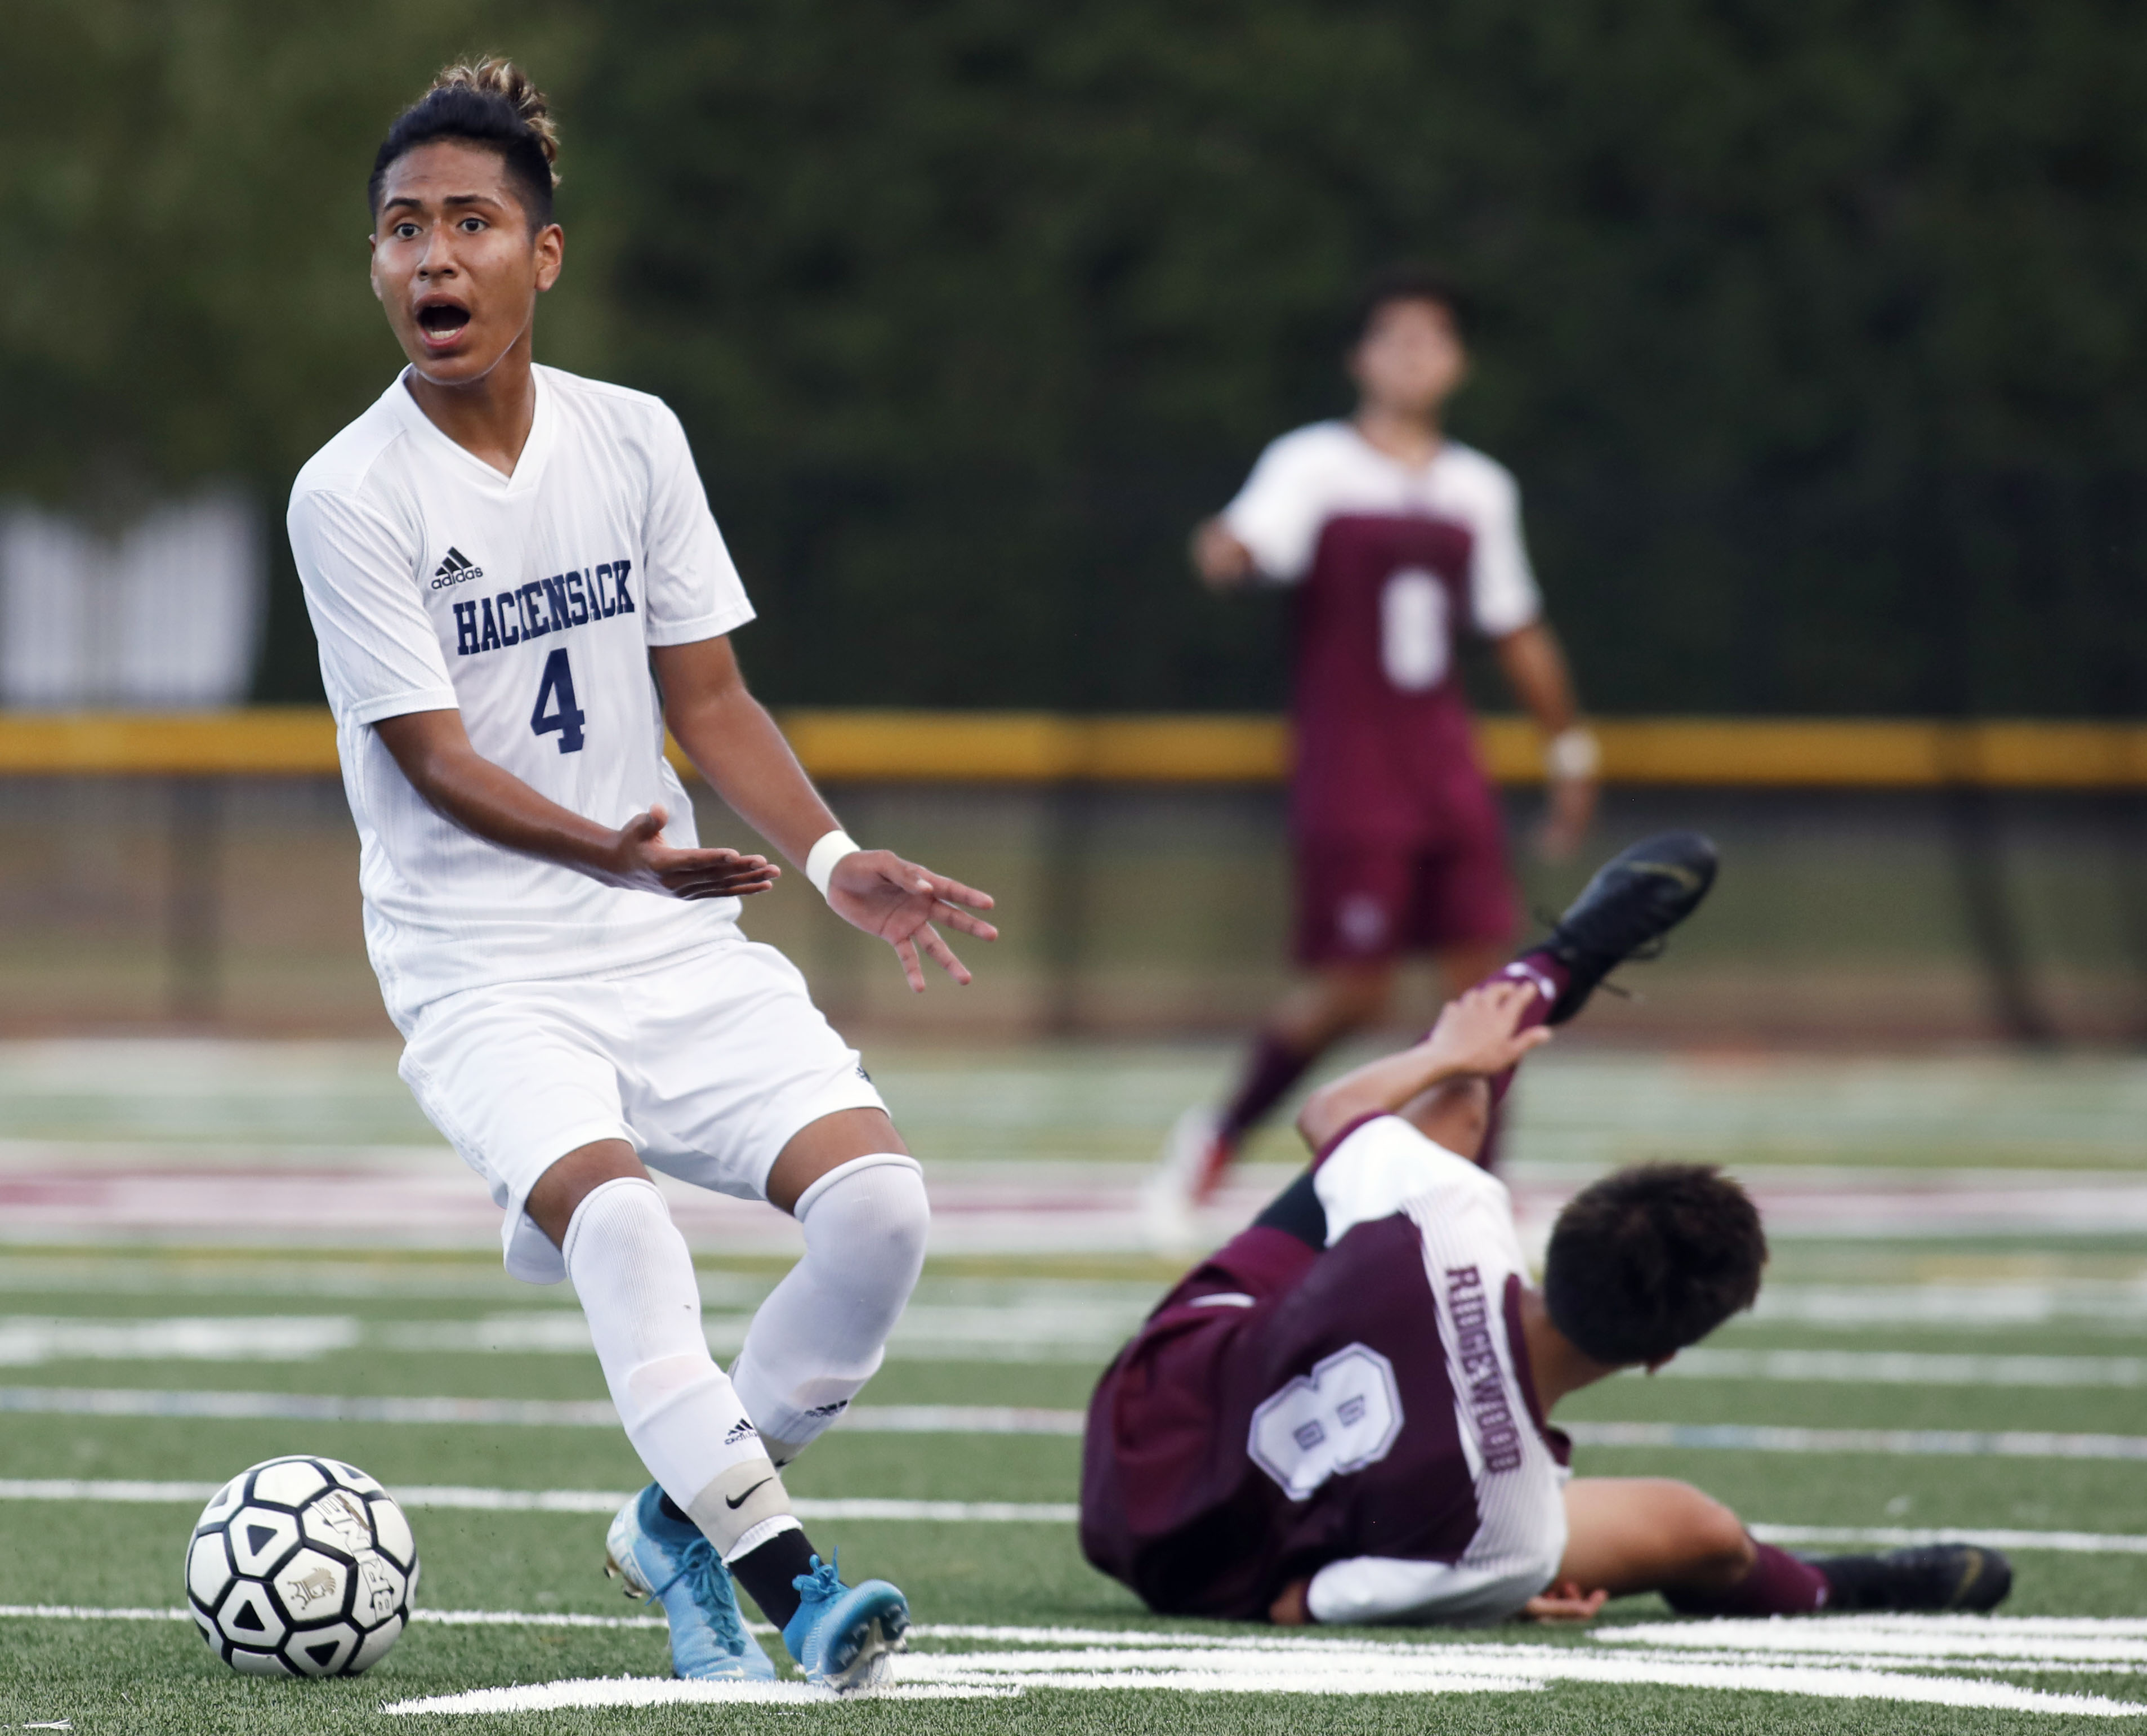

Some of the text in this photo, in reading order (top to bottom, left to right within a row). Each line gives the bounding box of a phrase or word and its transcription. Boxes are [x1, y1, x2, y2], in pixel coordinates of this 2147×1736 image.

[431, 566, 483, 590] adidas
[530, 648, 585, 754] 4
[1247, 1342, 1404, 1502] 8
[1446, 1266, 1521, 1473] RIDGEWOOD
[311, 1493, 395, 1624] BRINE
